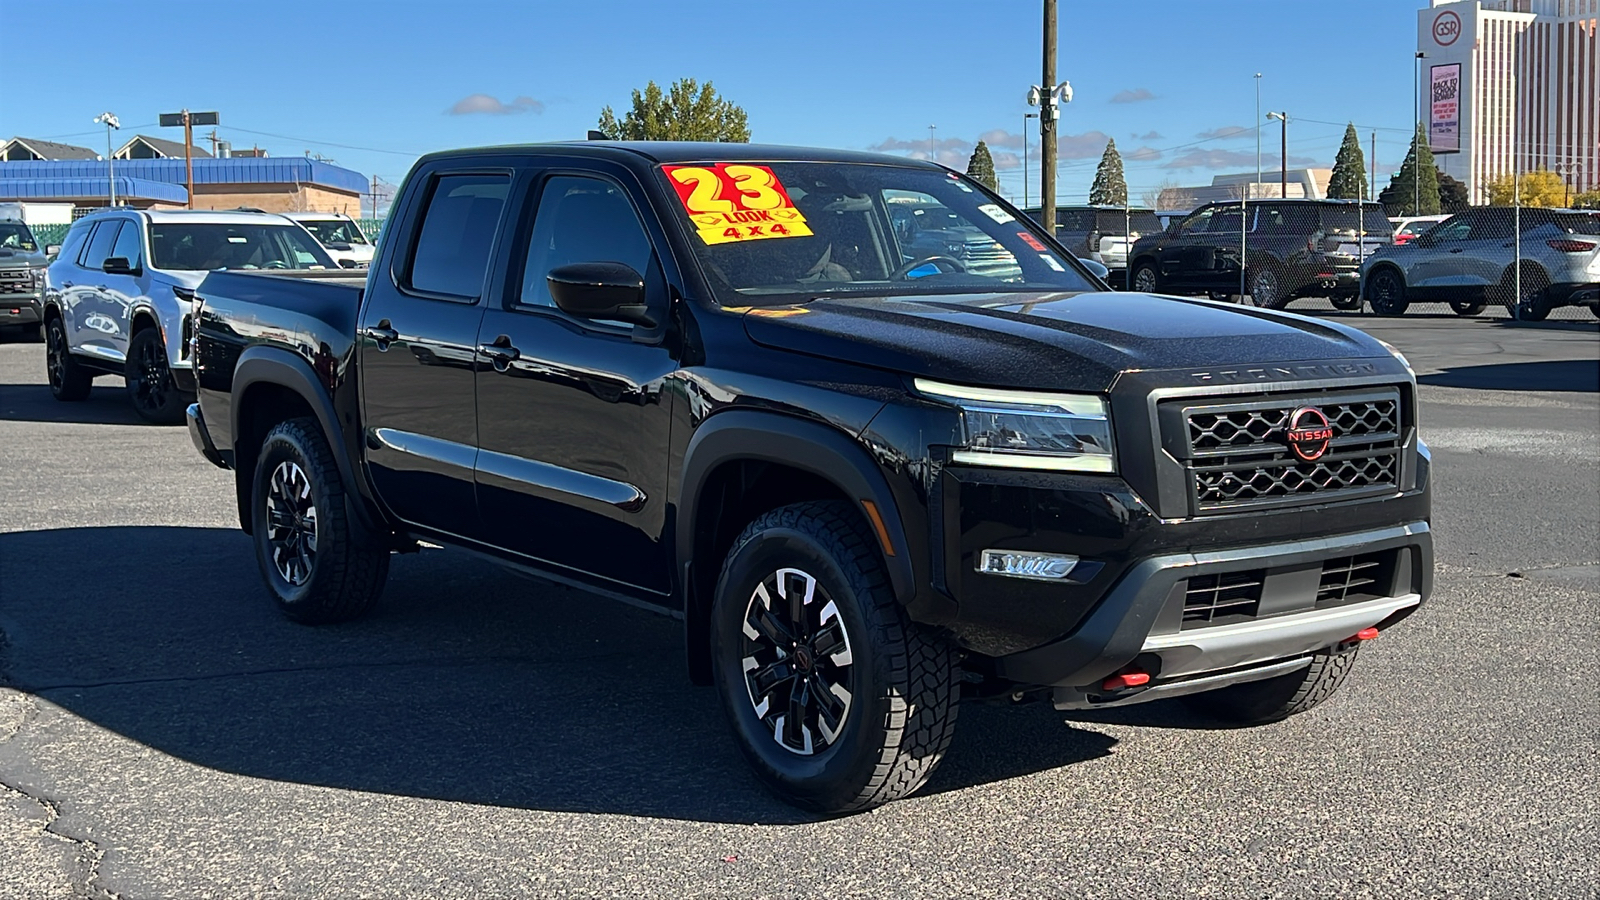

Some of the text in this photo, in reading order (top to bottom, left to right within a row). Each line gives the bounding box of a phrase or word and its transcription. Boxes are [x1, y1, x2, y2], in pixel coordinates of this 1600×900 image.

[1436, 21, 1457, 36] GSR
[671, 165, 786, 212] 23
[722, 210, 775, 224] LOOK
[1191, 363, 1374, 383] FRONTIER
[1288, 428, 1333, 441] NISSAN
